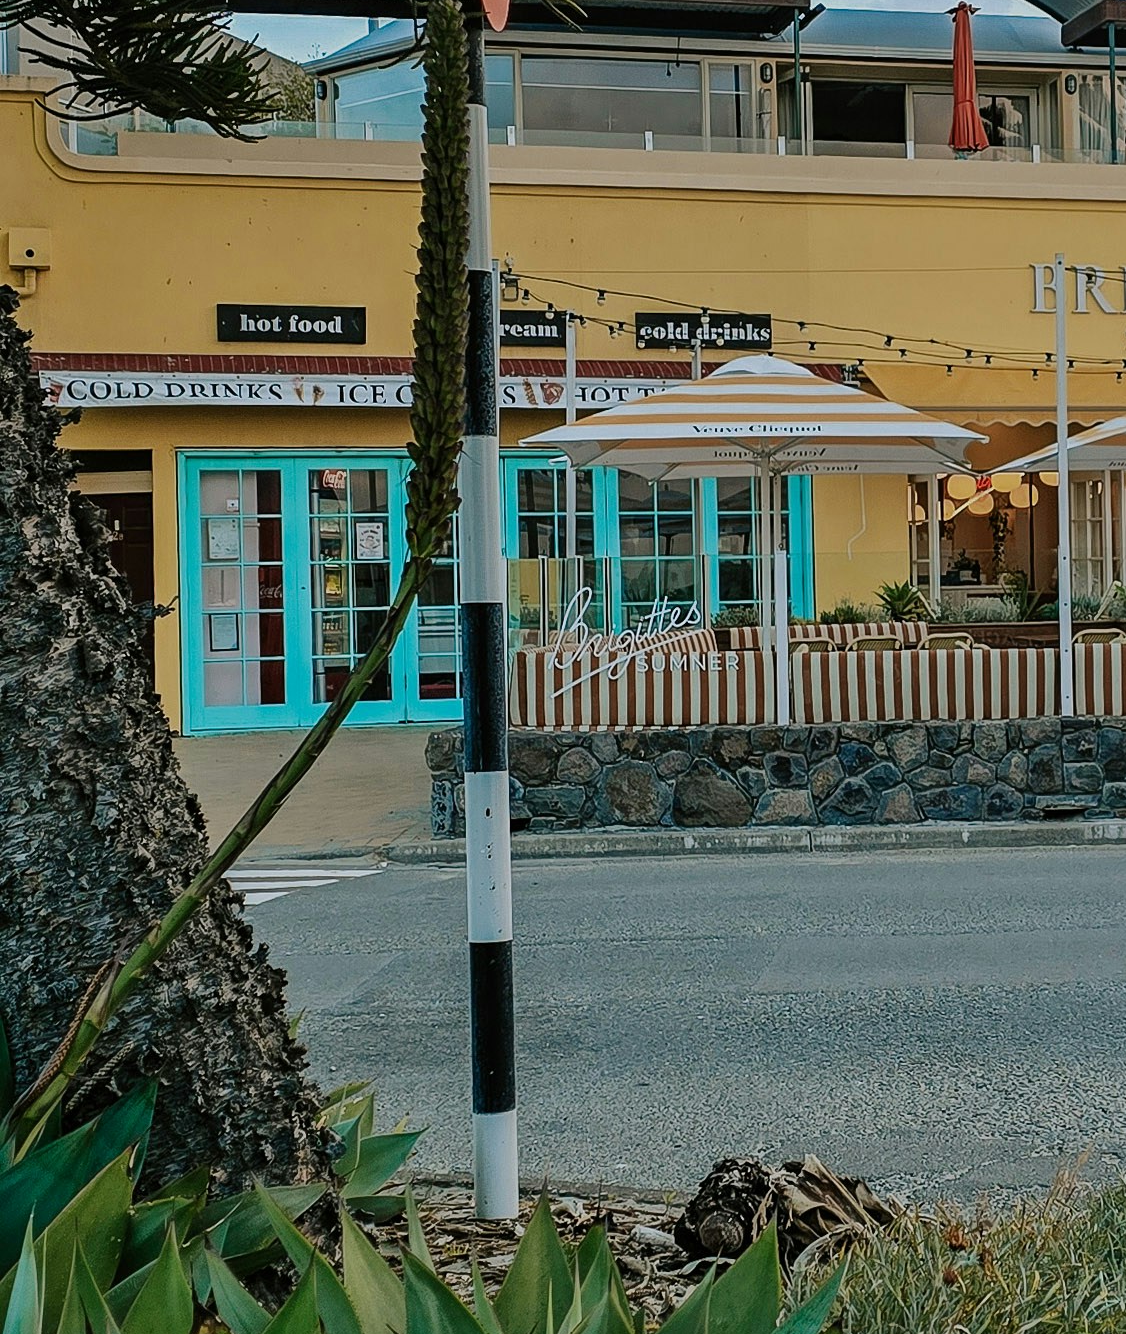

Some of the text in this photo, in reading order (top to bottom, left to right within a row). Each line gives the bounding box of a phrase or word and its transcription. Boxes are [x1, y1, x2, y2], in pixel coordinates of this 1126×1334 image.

[239, 314, 343, 334] hot food
[500, 323, 559, 337] ream
[640, 321, 770, 342] cold drinks
[66, 379, 283, 401] COLD DRINKS
[336, 384, 387, 405] ICE
[692, 424, 824, 434] Veuve Clicquot
[548, 586, 702, 680] Brigittes
[636, 652, 740, 673] SUMNER
